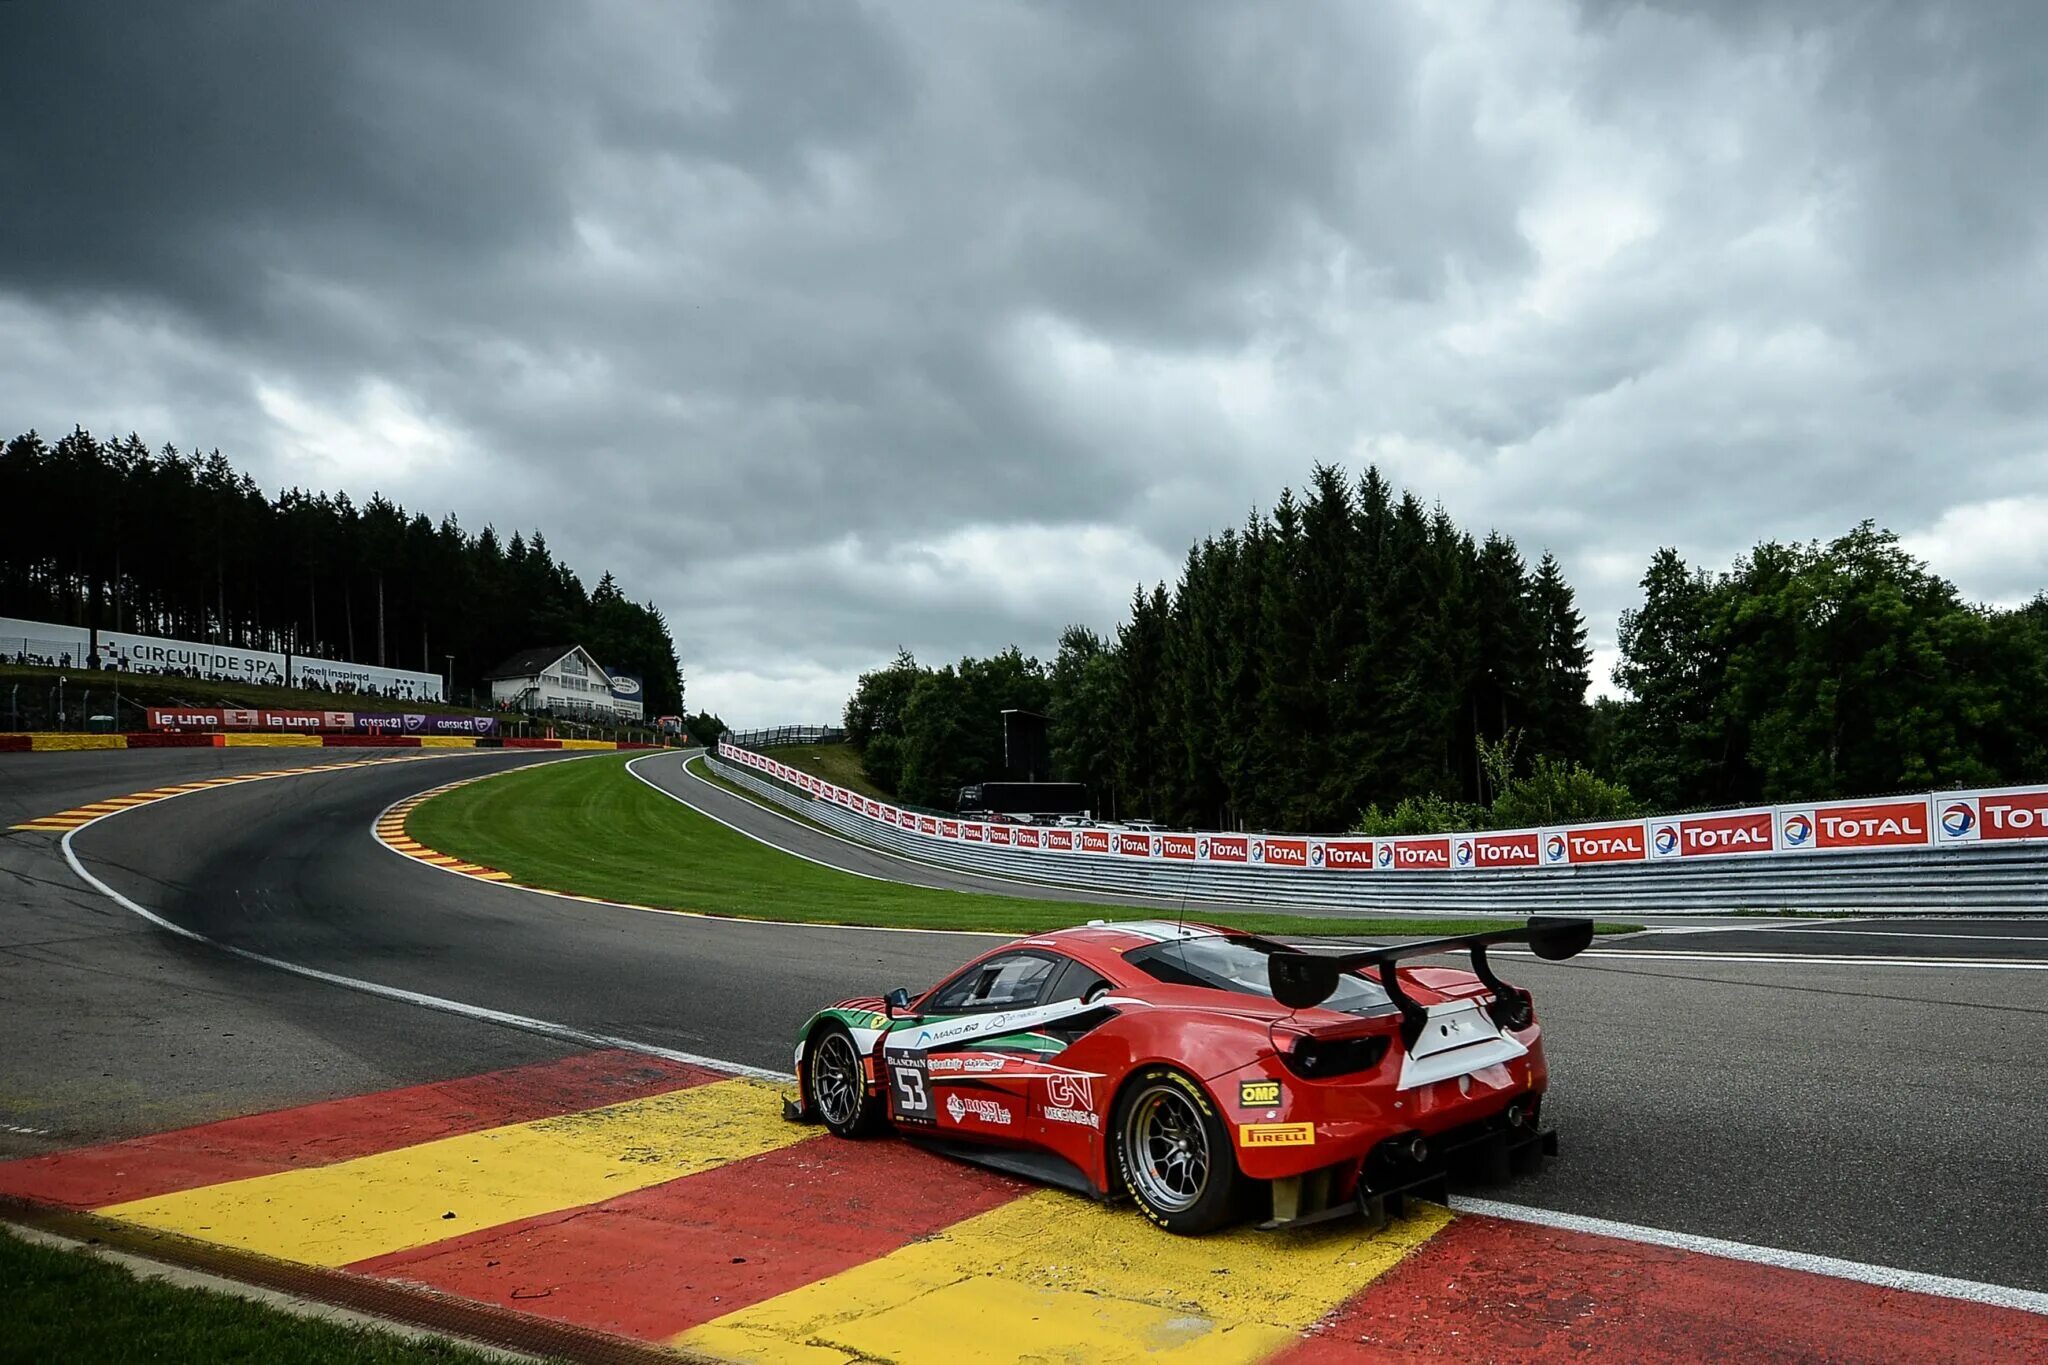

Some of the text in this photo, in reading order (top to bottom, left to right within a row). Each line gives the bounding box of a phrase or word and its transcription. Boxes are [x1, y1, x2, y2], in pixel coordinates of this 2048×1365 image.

[133, 645, 209, 667] CIRCUIT
[215, 655, 239, 671] DE
[244, 659, 279, 677] SPA
[942, 824, 958, 836] TOTAL
[964, 827, 982, 838] TOTAL
[1820, 816, 1923, 838] TOTAL
[990, 830, 1010, 841] TOTAL
[1018, 832, 1039, 844] TOTAL
[1049, 835, 1072, 847] TOTAL
[1083, 836, 1108, 849] TOTAL
[1684, 826, 1768, 848] TOTAL
[1122, 837, 1149, 853] TOTAL
[1164, 840, 1194, 856] TOTAL
[1211, 841, 1246, 858] TOTAL
[1267, 845, 1305, 861] TOTAL
[1477, 844, 1537, 861] TOTAL
[1570, 836, 1642, 856] TOTAL
[1326, 848, 1371, 864] TOTAL
[1396, 846, 1448, 863] TOTAL
[887, 1056, 926, 1068] BLANCPAIN
[895, 1067, 927, 1110] 53
[1242, 1086, 1279, 1101] OMP
[1248, 1127, 1307, 1142] PIRELLI
